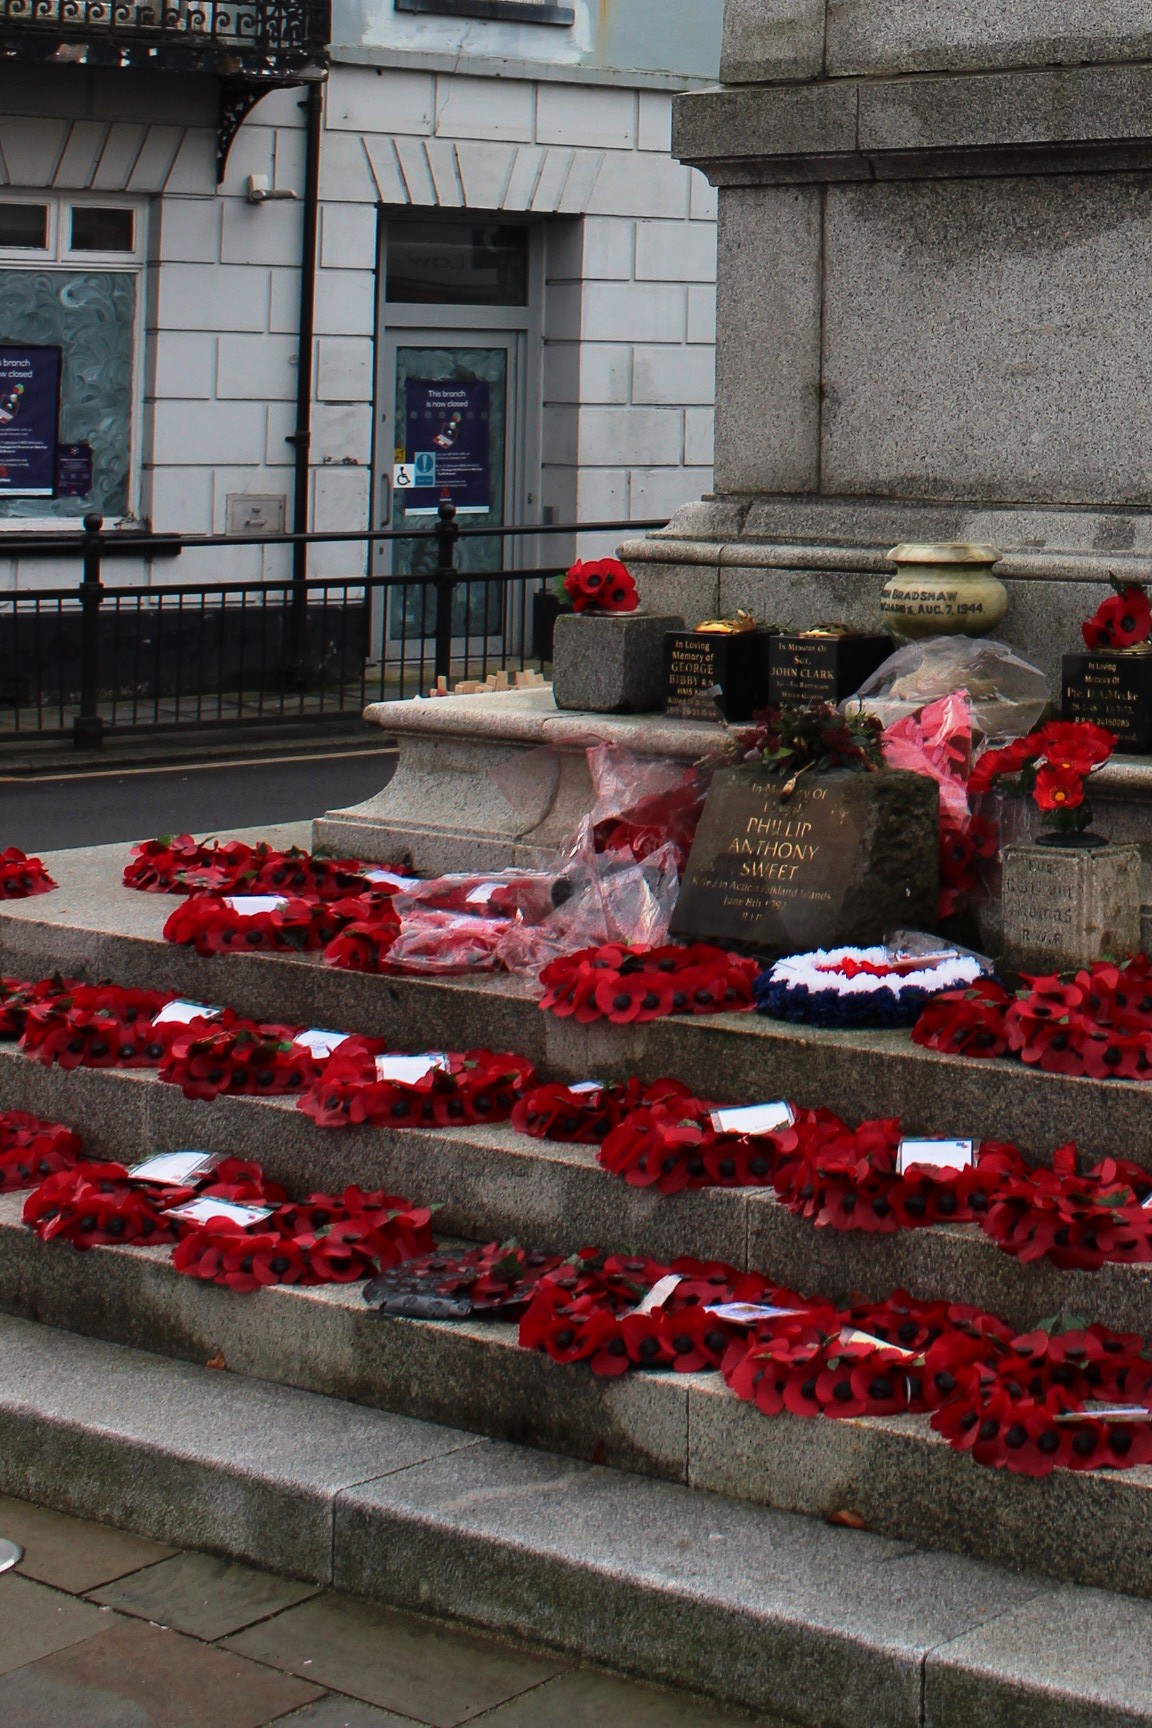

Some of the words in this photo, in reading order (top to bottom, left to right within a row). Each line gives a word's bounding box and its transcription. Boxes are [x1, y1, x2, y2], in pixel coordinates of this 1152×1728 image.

[3, 358, 31, 367] branch
[8, 370, 33, 378] closed
[428, 390, 441, 398] This
[442, 390, 466, 398] branch
[447, 400, 468, 408] closed
[675, 640, 684, 649] In
[685, 640, 710, 652] Loving
[672, 651, 704, 663] Memory
[705, 653, 714, 662] of
[671, 662, 714, 675] GEORGE
[771, 666, 798, 678] JOHN
[800, 668, 834, 680] CLARK
[669, 674, 698, 686] BIBBY
[677, 687, 693, 696] HMS
[752, 783, 761, 793] In
[812, 788, 828, 800] Of
[746, 817, 812, 838] PHILLIP
[728, 837, 820, 862] ANTHONY
[740, 861, 799, 880] SWEET
[723, 896, 743, 907] June
